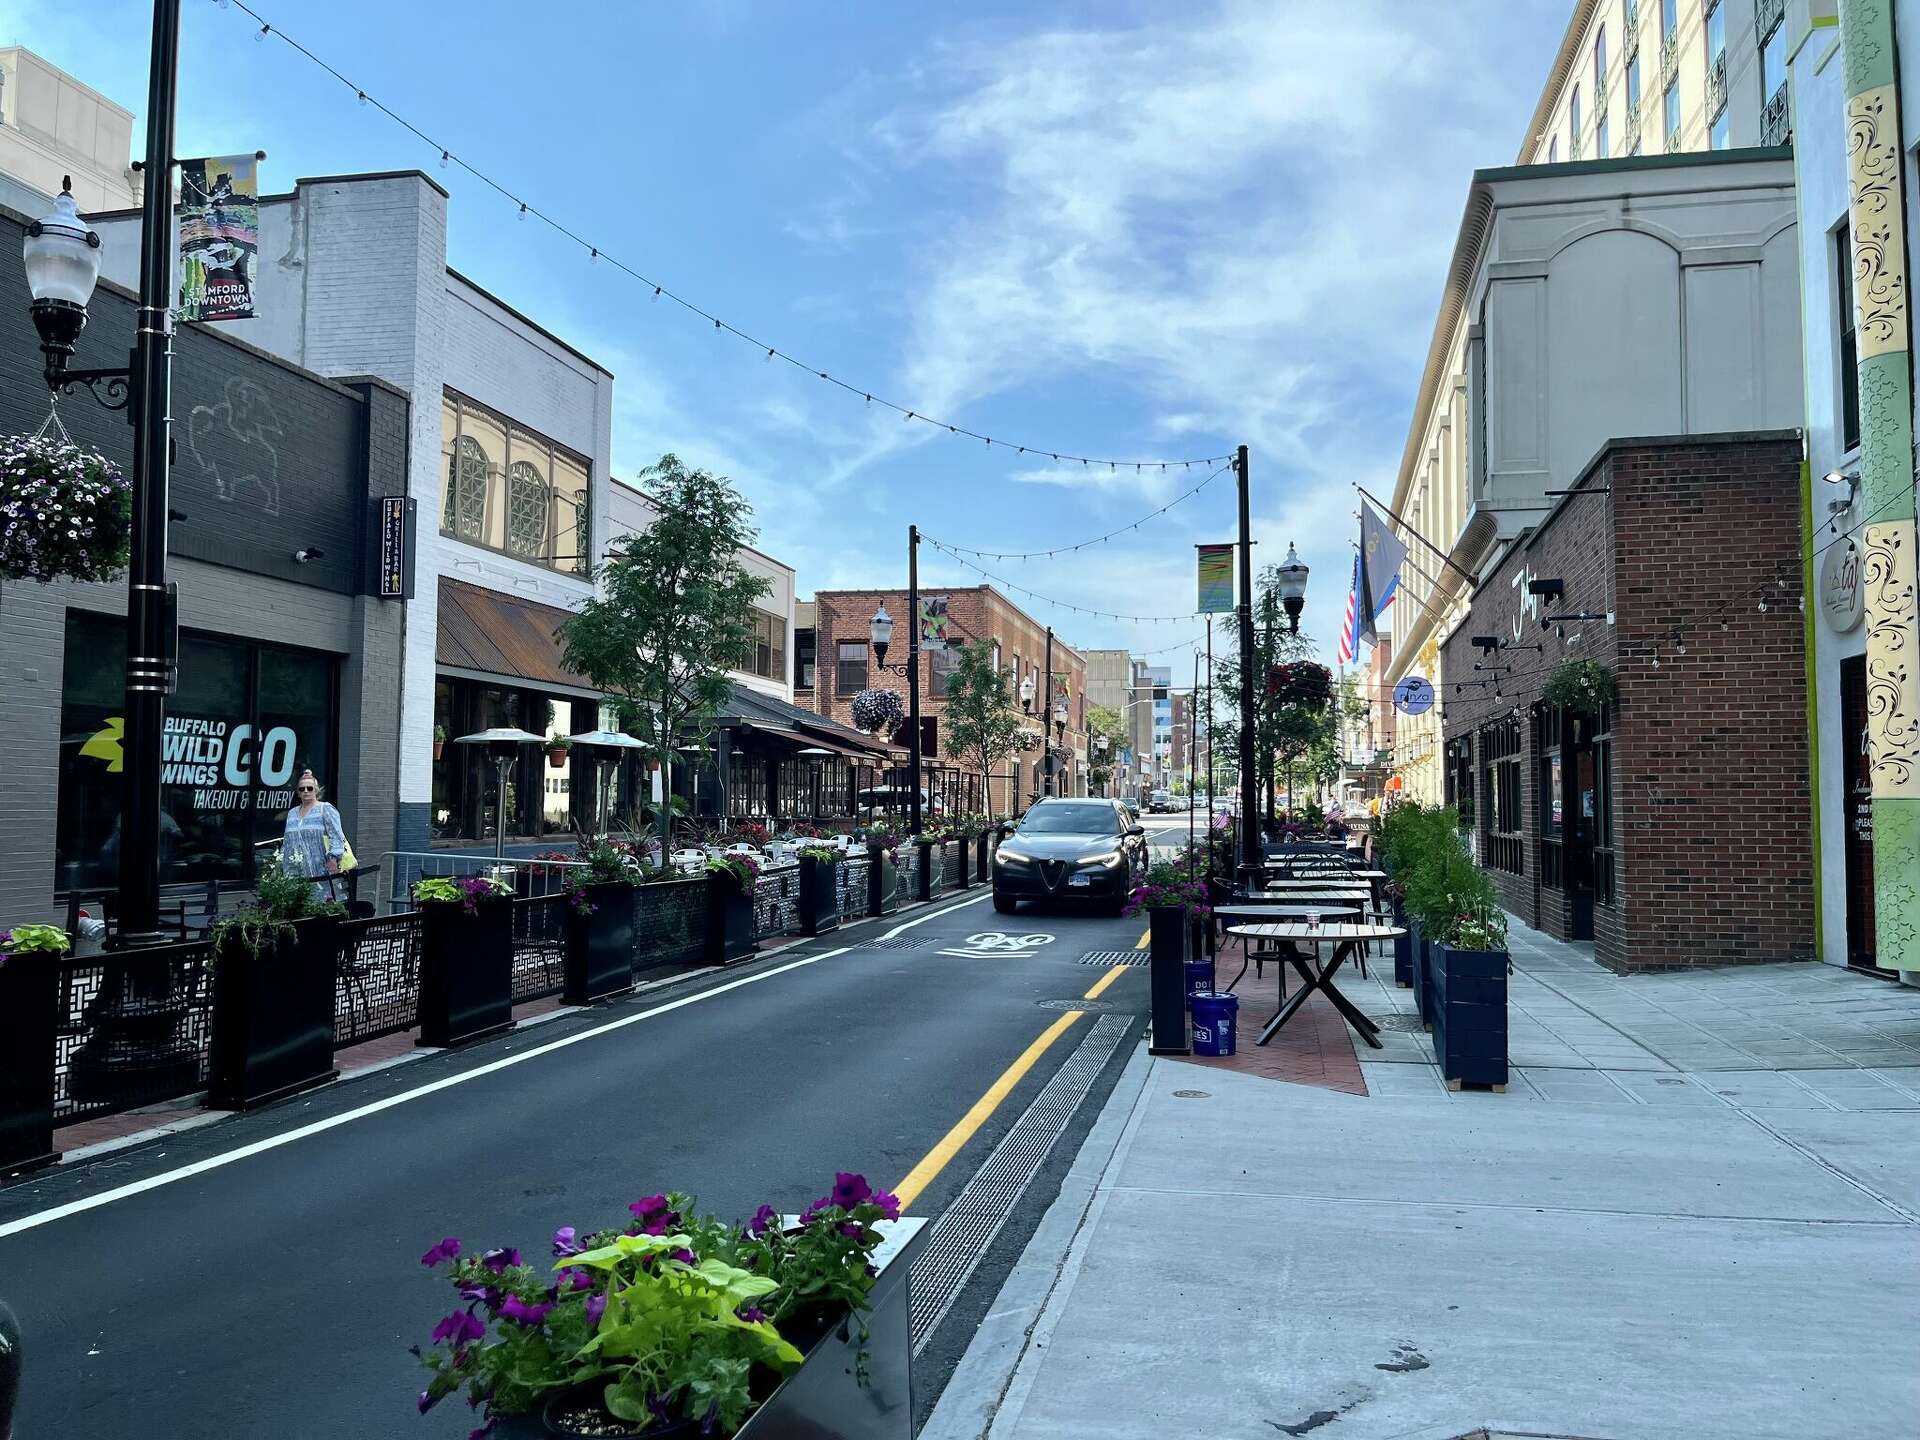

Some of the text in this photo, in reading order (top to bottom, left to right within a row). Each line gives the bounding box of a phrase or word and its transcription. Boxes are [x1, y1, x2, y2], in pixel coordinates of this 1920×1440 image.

[185, 294, 249, 307] DOWNTOWN
[189, 285, 245, 296] STAMFORD
[384, 541, 392, 563] WILD
[163, 716, 226, 736] BUFFALO
[162, 734, 223, 763] WILD
[225, 724, 297, 786] GO
[161, 764, 219, 785] WINGS
[193, 789, 240, 809] TAKEOUT
[256, 791, 295, 809] ELIVERY
[1858, 818, 1873, 828] PLEAS
